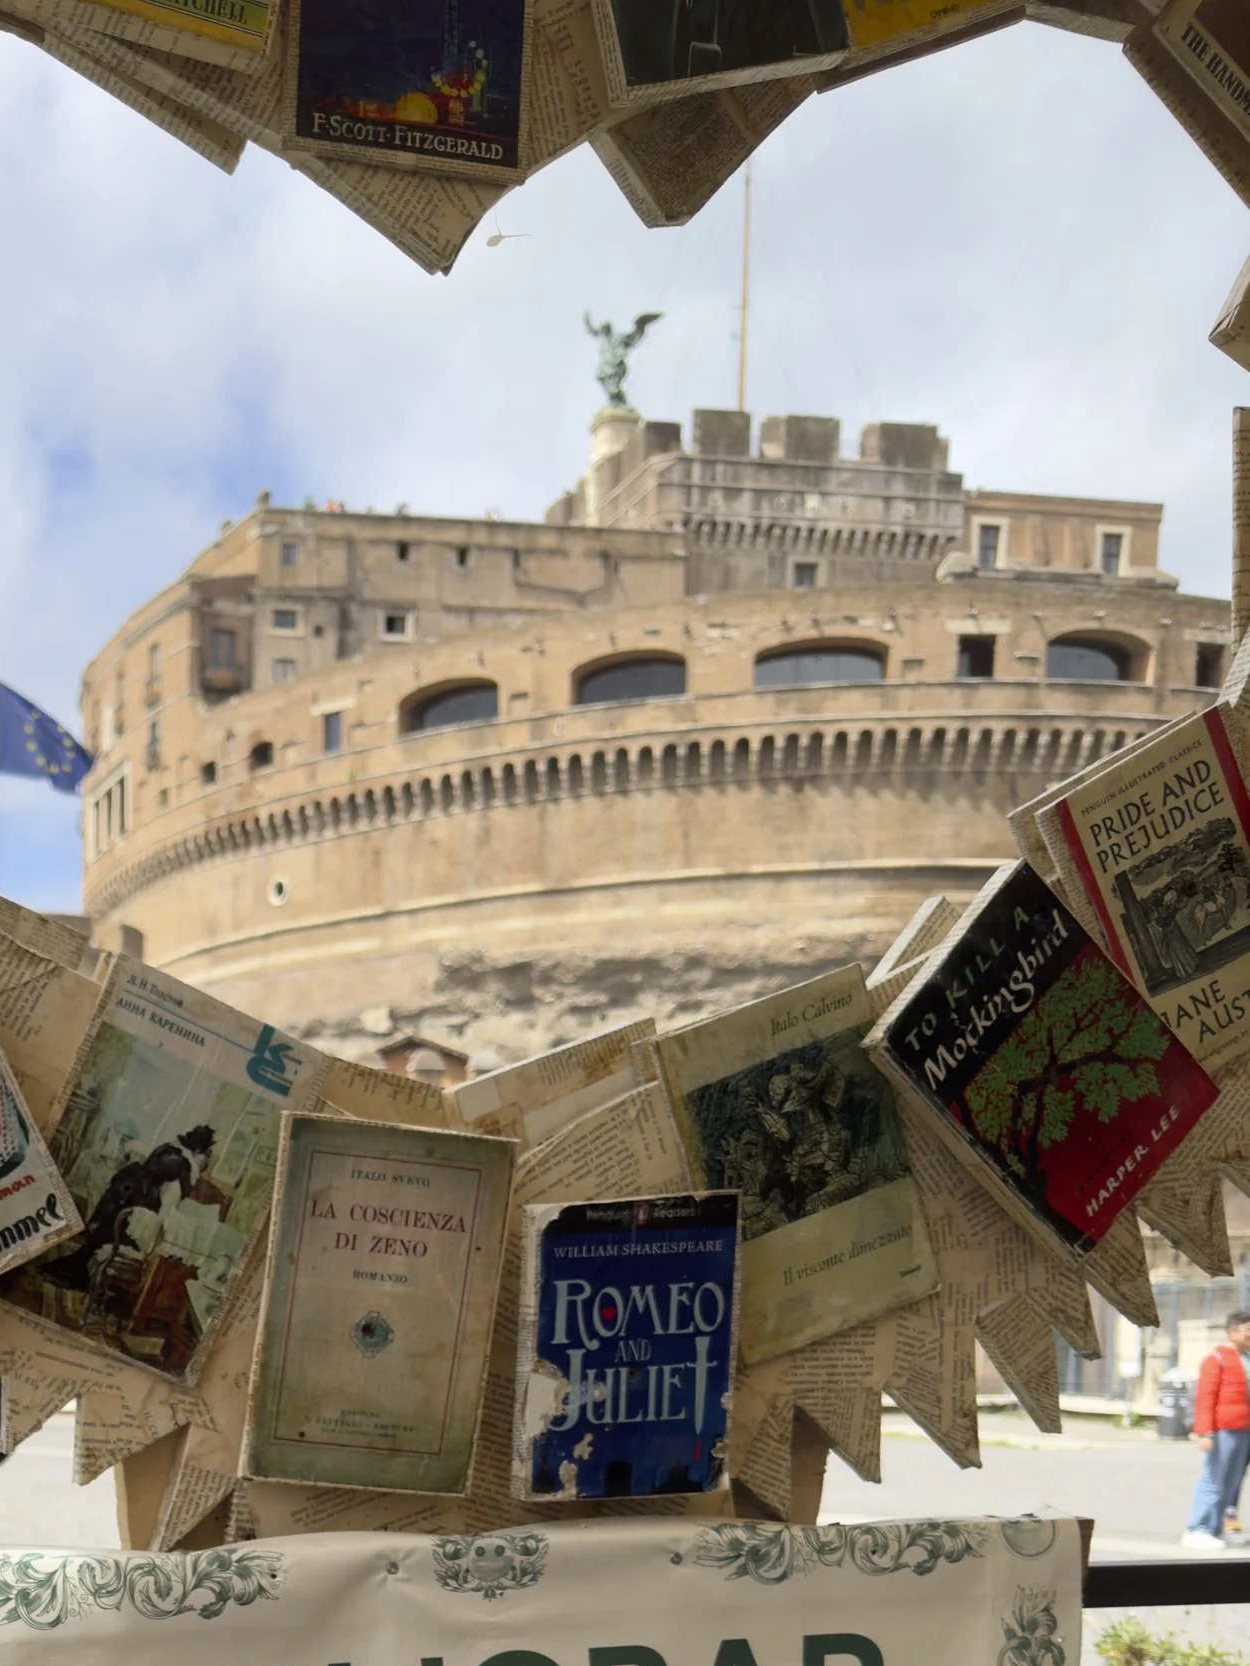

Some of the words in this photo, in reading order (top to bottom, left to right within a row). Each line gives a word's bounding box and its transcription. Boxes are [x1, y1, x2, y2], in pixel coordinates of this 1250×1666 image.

[1181, 22, 1211, 62] THE
[1080, 790, 1116, 817] PENGUIN
[1116, 761, 1167, 795] ILLUSTRATED
[1169, 739, 1204, 764] CLASSICS
[1089, 792, 1156, 849] PRIDE
[1161, 759, 1213, 807] AND
[1096, 782, 1225, 874] PREJUDICE
[904, 1012, 938, 1051] TO
[946, 938, 1006, 1008] KILL
[1012, 906, 1030, 932] A
[922, 908, 1069, 1091] Mockingbird
[115, 997, 147, 1019] АННА
[149, 1011, 206, 1048] КАРЕНИНА
[771, 1008, 800, 1037] Italo
[801, 993, 853, 1023] Calvino
[350, 1167, 387, 1184] ITALO
[1085, 1144, 1149, 1218] HARPER
[1150, 1104, 1181, 1142] LEE
[310, 1199, 337, 1220] LA
[349, 1203, 467, 1234] COSCIENZA
[334, 1232, 358, 1252] DI
[368, 1235, 429, 1259] ZENO
[554, 1243, 618, 1260] WILLIAM
[621, 1239, 725, 1257] SHAKESPEARE
[782, 1268, 794, 1287] Il
[796, 1250, 846, 1281] visconte
[847, 1223, 914, 1260] dimezzato
[352, 1268, 409, 1285] ROMANZO
[550, 1279, 727, 1351] ROMEO
[615, 1339, 652, 1363] AND
[549, 1336, 719, 1434] JULIET
